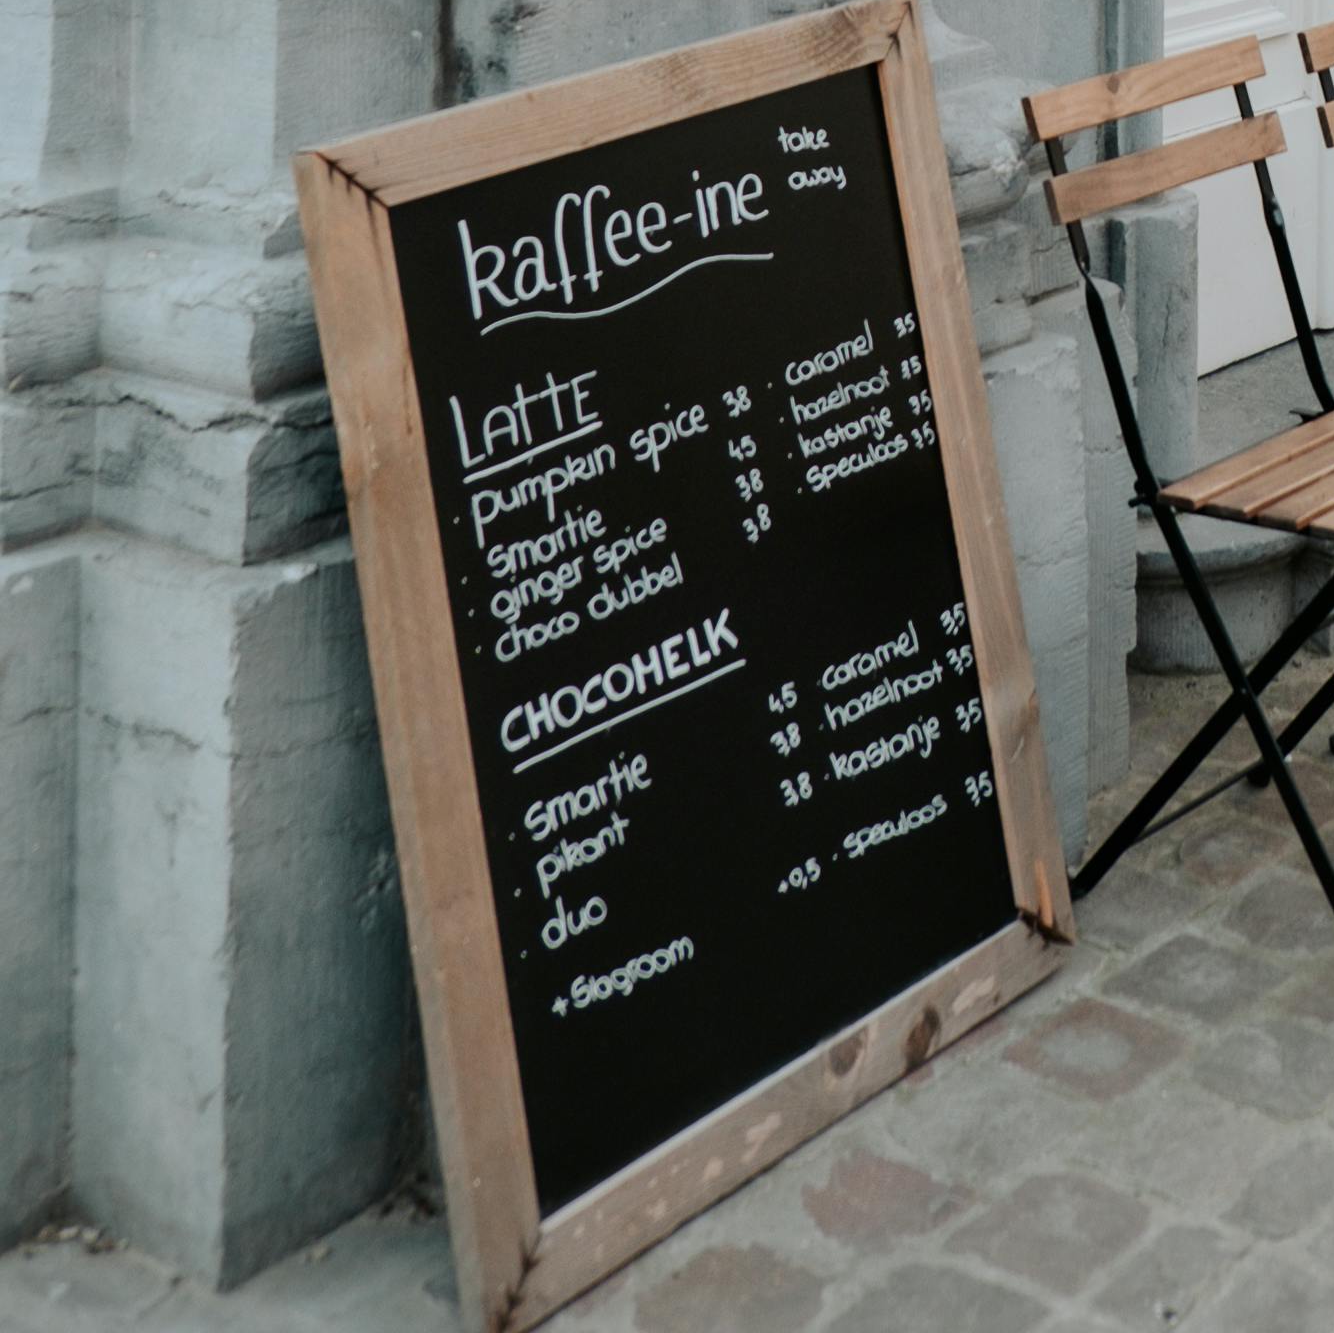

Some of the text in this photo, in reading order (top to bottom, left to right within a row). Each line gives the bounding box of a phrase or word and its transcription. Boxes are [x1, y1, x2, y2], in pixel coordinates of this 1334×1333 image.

[778, 125, 830, 153] take
[788, 162, 846, 191] away
[457, 170, 769, 320] kaffee-ine
[785, 318, 875, 386] caramel
[789, 364, 891, 426] hazelnoot
[797, 405, 894, 459] kastanje
[471, 443, 616, 550] pumpkin
[629, 402, 710, 473] spice
[486, 504, 608, 579] smartie
[490, 555, 585, 625] ginger
[592, 517, 668, 574] spice
[495, 610, 580, 662] choco
[587, 551, 684, 621] dubbel
[500, 607, 741, 754] CHOCOMELK
[822, 619, 920, 691] caramel
[824, 658, 944, 732] hazelnoot
[829, 715, 941, 780] kastanje
[523, 751, 652, 842] smartie
[536, 811, 630, 899] pikant
[541, 895, 608, 950] duo
